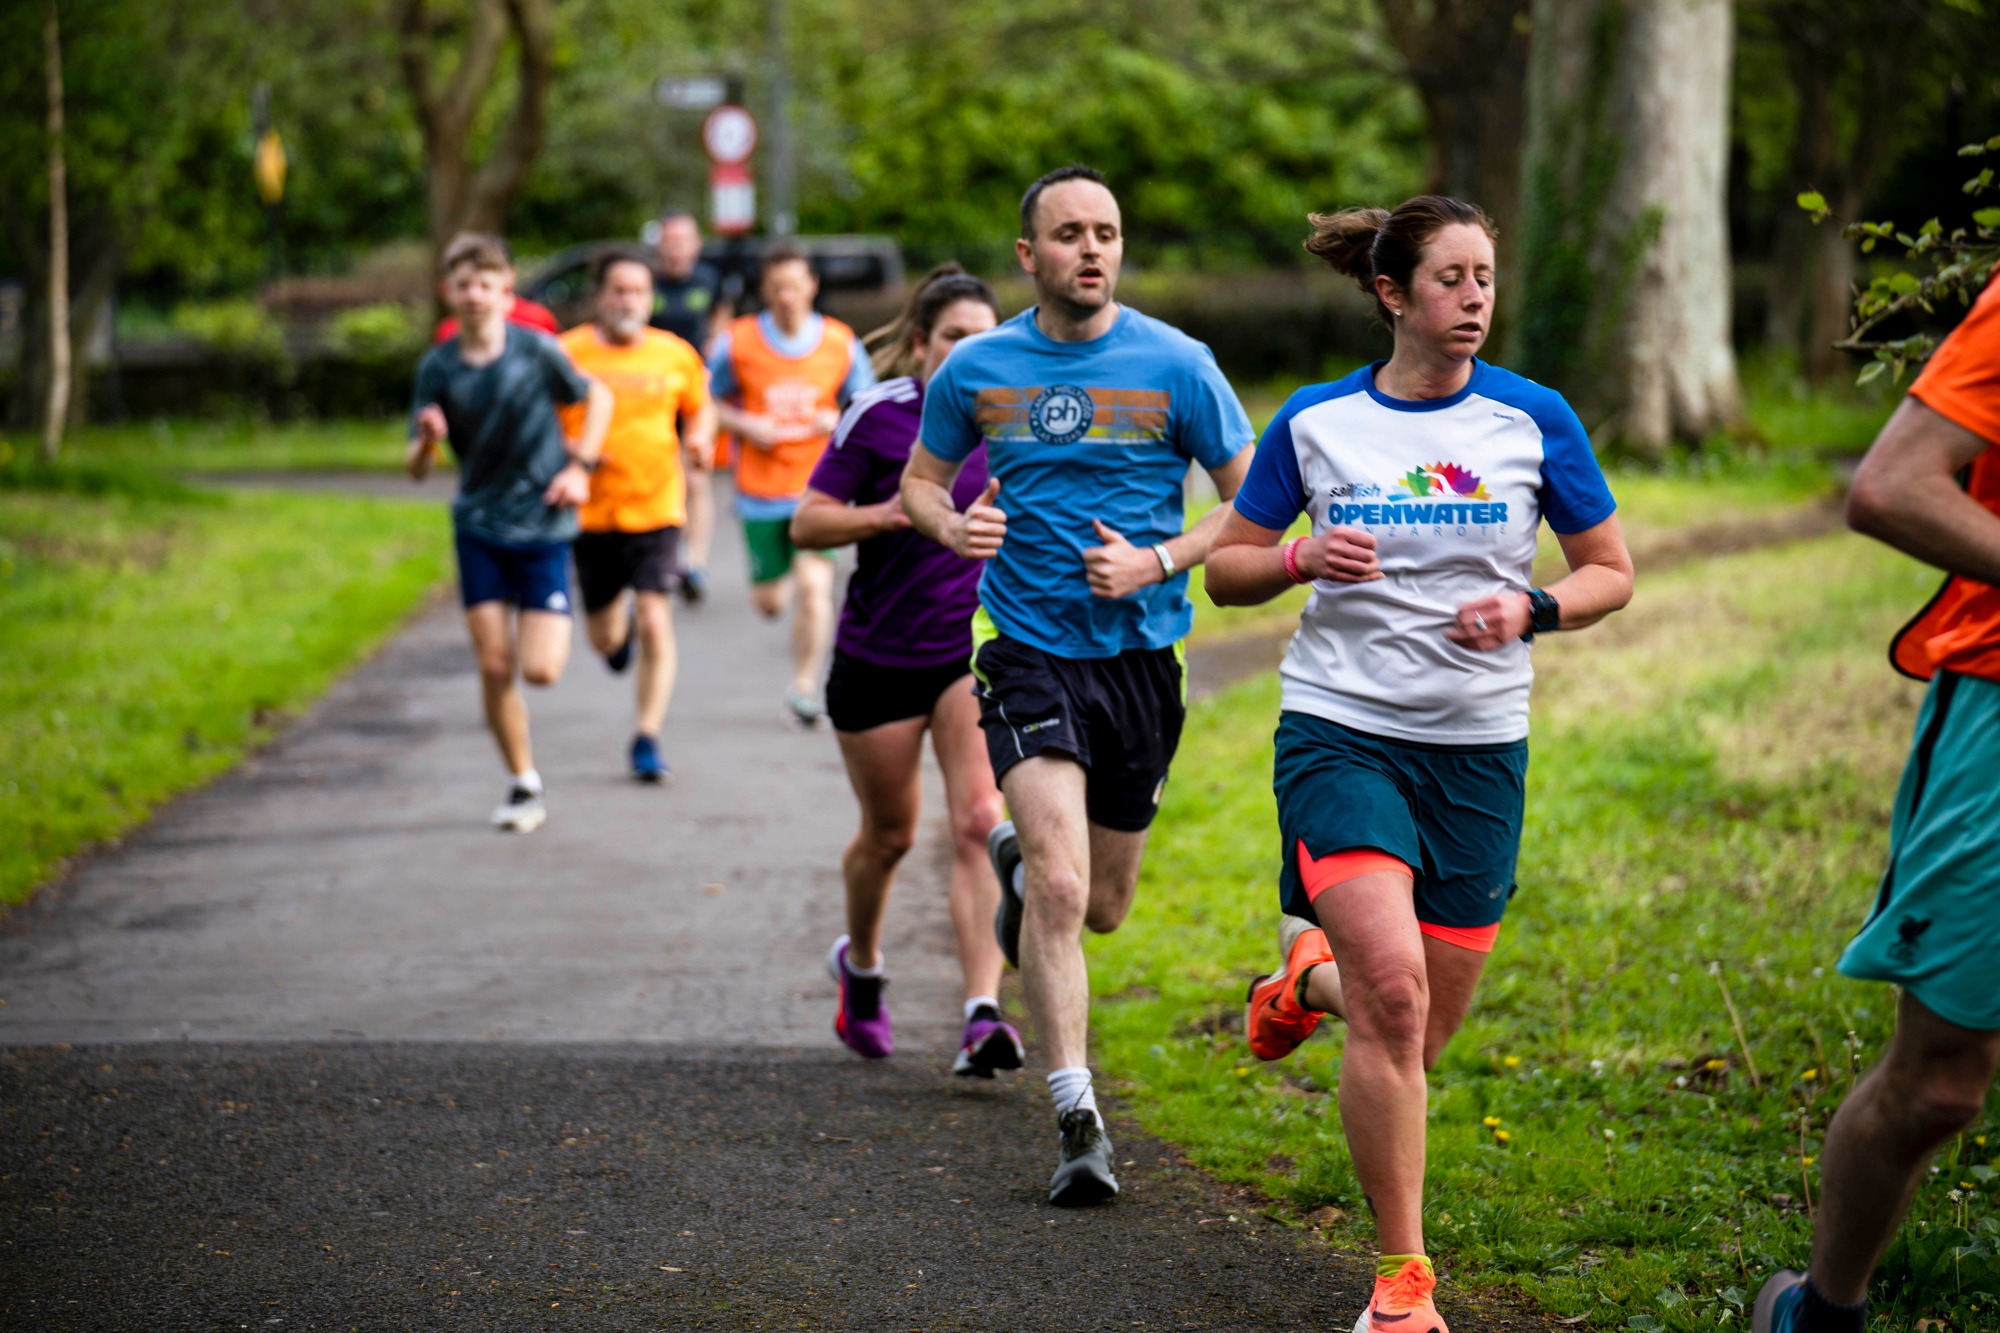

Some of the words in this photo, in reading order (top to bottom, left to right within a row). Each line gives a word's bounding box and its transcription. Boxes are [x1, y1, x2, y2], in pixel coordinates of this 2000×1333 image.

[1045, 398, 1078, 427] ph
[1035, 428, 1052, 442] LAS
[1054, 429, 1082, 444] VEGAS
[1329, 503, 1508, 525] OPENWATER
[1364, 524, 1507, 537] NZAROTE
